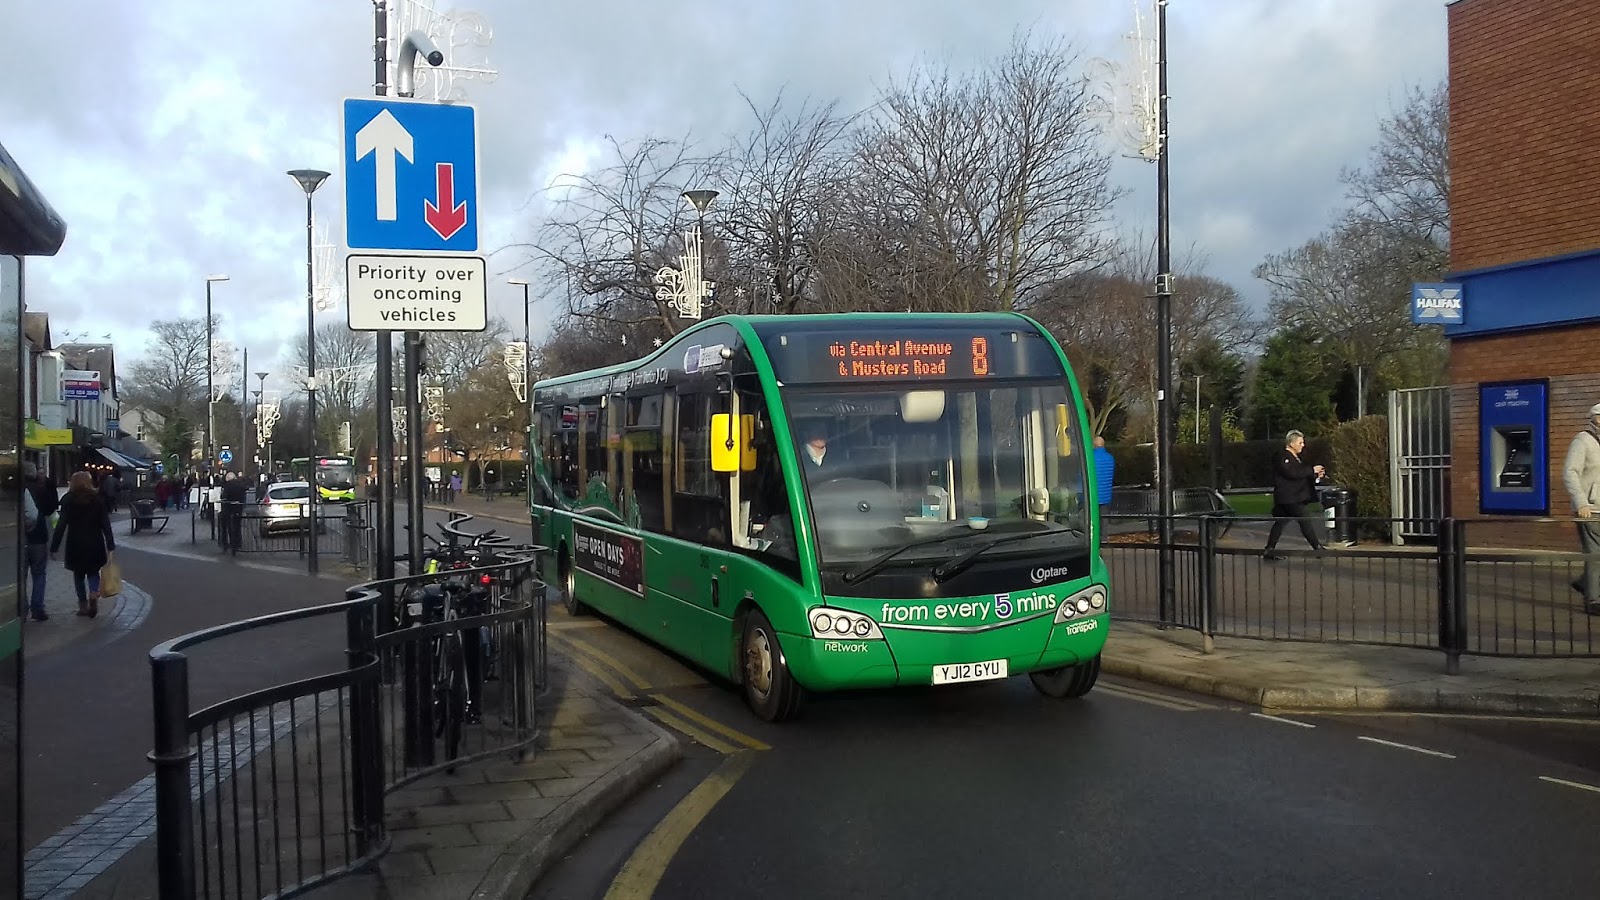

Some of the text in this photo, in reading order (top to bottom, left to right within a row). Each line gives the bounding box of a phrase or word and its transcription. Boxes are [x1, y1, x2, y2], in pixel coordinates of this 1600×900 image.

[358, 264, 474, 283] Priority over
[373, 286, 461, 303] oncoming
[1416, 298, 1461, 308] HALIFAX
[380, 306, 456, 322] vehicles
[829, 340, 953, 357] via Central Avenue
[971, 337, 988, 376] 8
[838, 358, 946, 376] & Musters Road
[590, 536, 606, 558] OPEN
[607, 542, 624, 565] DAYS
[1035, 566, 1068, 581] Optare
[881, 591, 1057, 622] from every 5 mins
[1066, 620, 1098, 635] Transport
[824, 641, 868, 652] network
[941, 662, 1000, 680] YJ12 GYU
